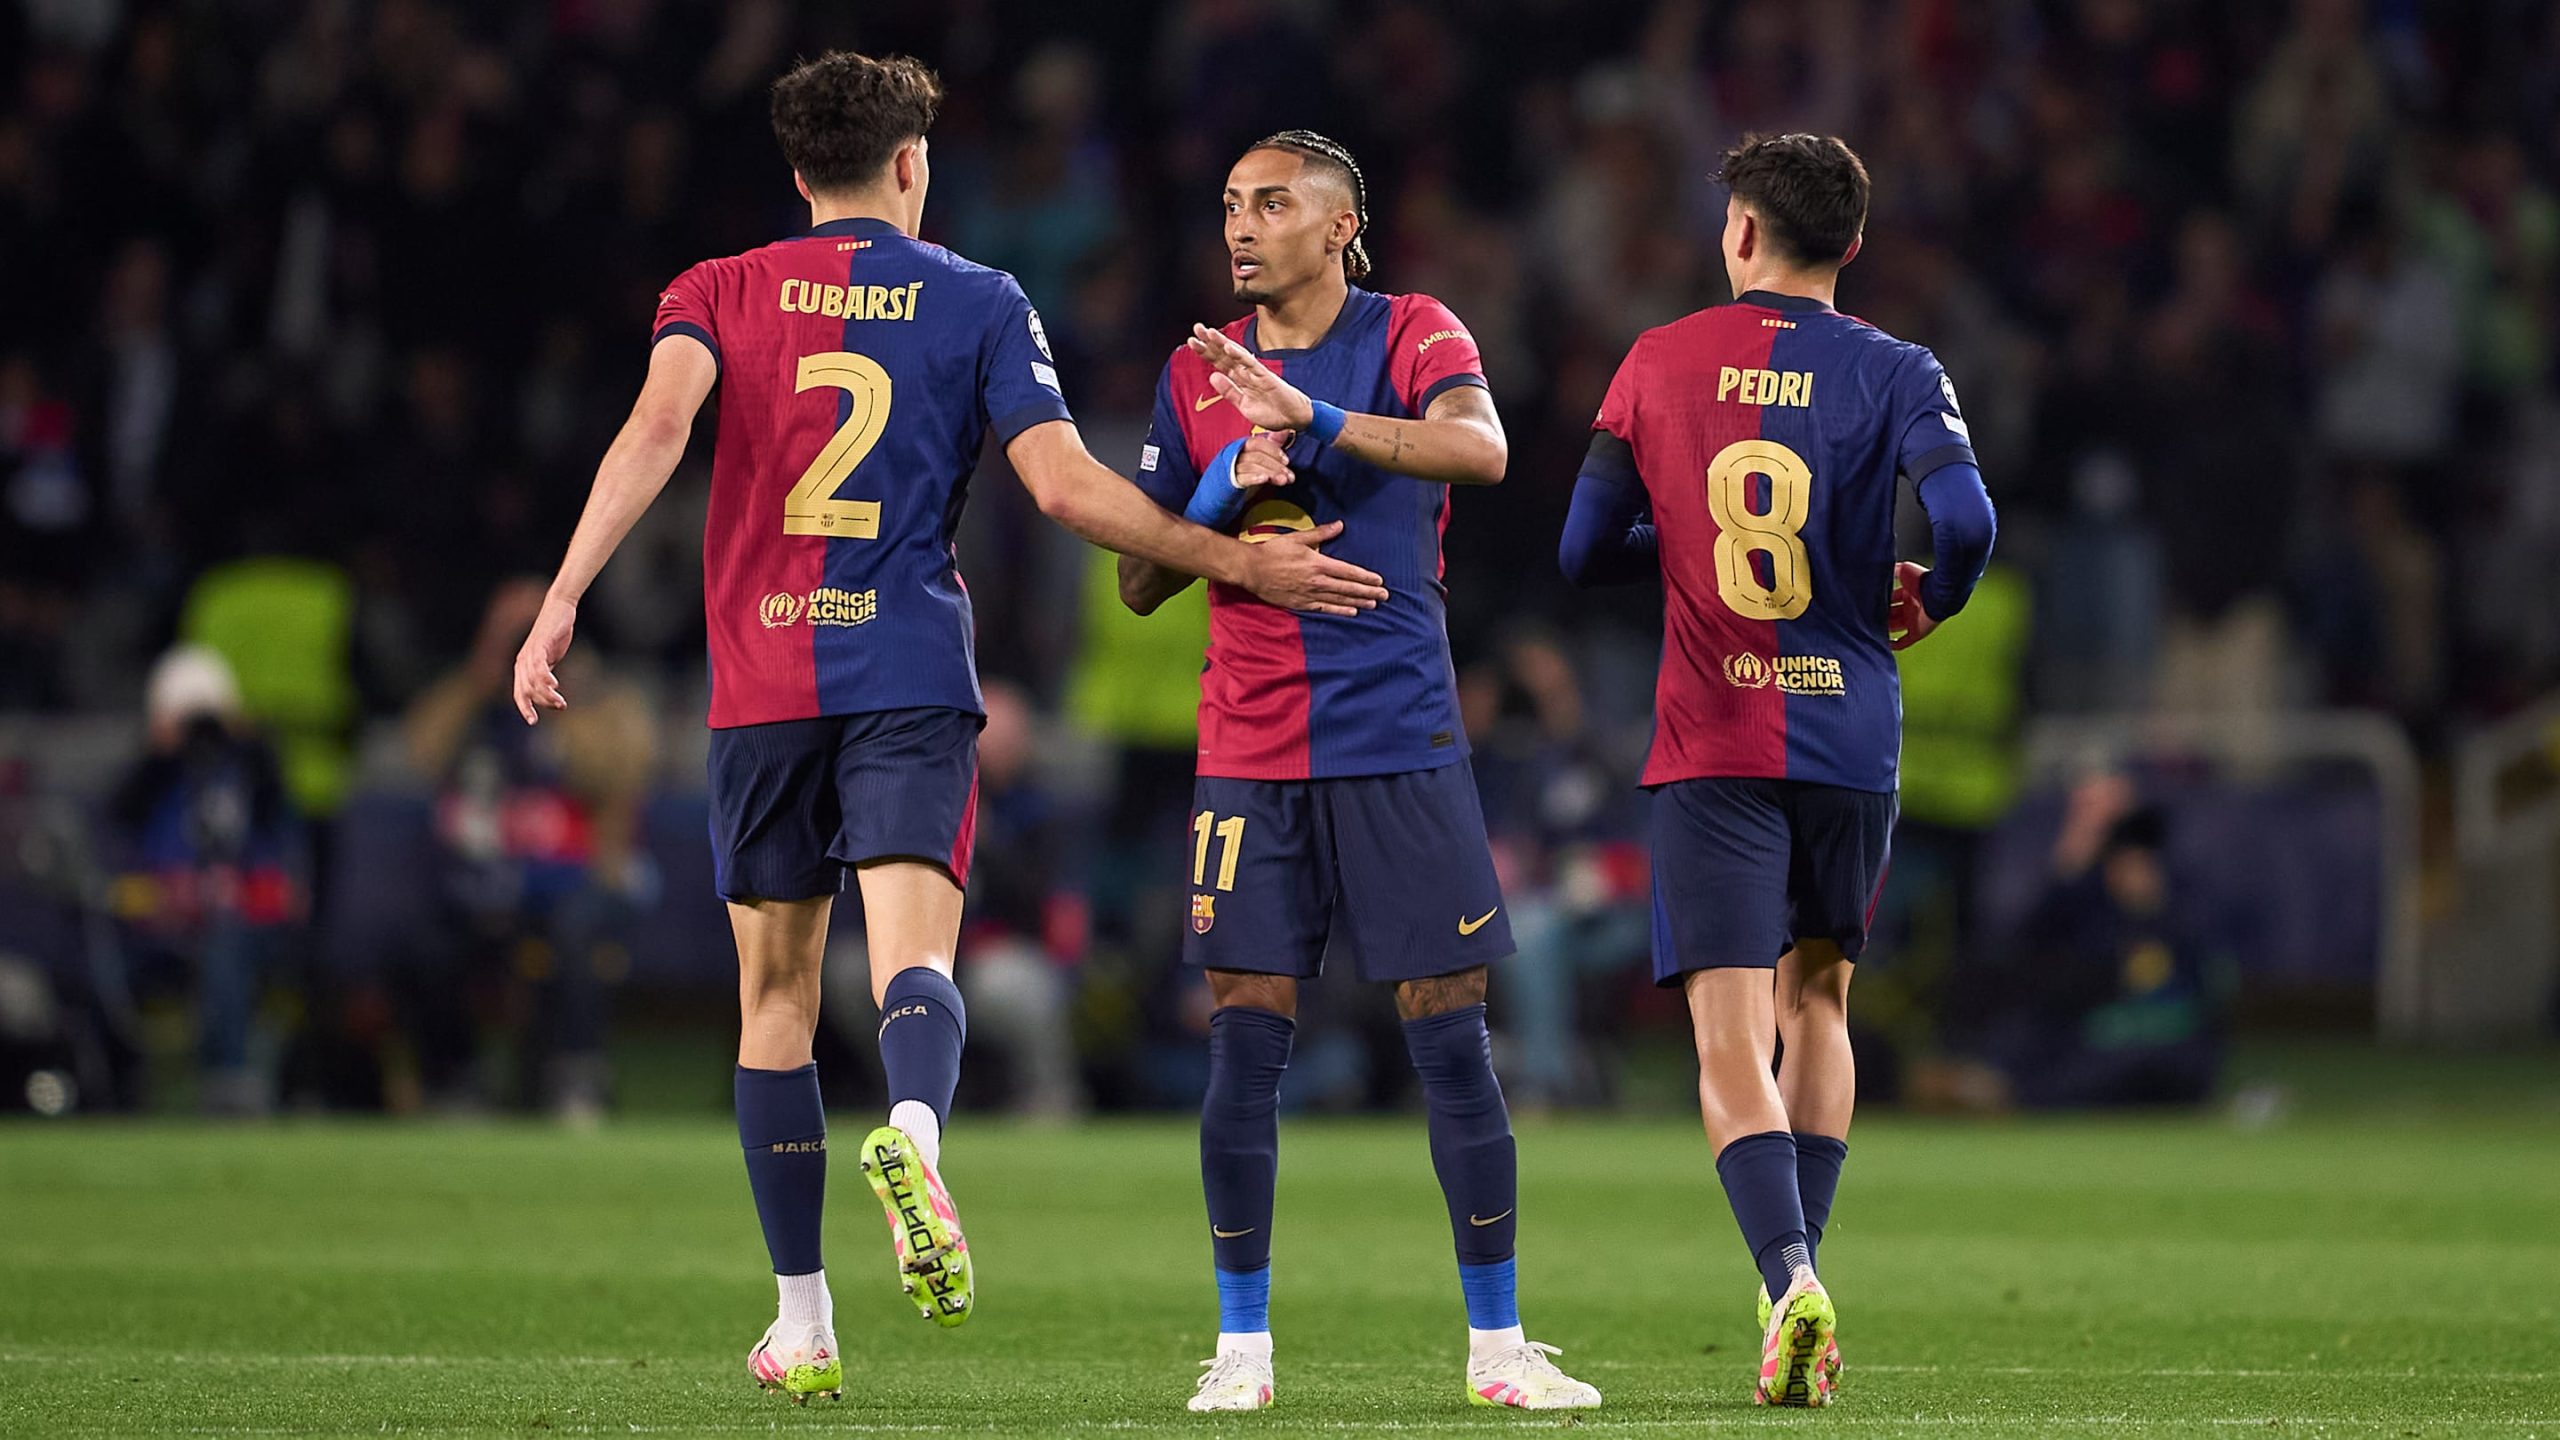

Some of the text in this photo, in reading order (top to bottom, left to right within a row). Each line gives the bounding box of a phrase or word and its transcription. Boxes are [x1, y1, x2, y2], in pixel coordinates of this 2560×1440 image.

[779, 278, 924, 321] CUBARSÍ
[1417, 329, 1473, 355] AMBILIG
[1717, 366, 1814, 407] PEDRI
[783, 351, 893, 540] 2
[1707, 439, 1813, 621] 8
[806, 602, 877, 621] ACNUR
[808, 587, 877, 607] UNHCR
[1772, 656, 1842, 673] UNHCR
[1774, 672, 1845, 689] ACNUR
[1193, 810, 1246, 891] 11
[879, 1005, 928, 1040] ARCA
